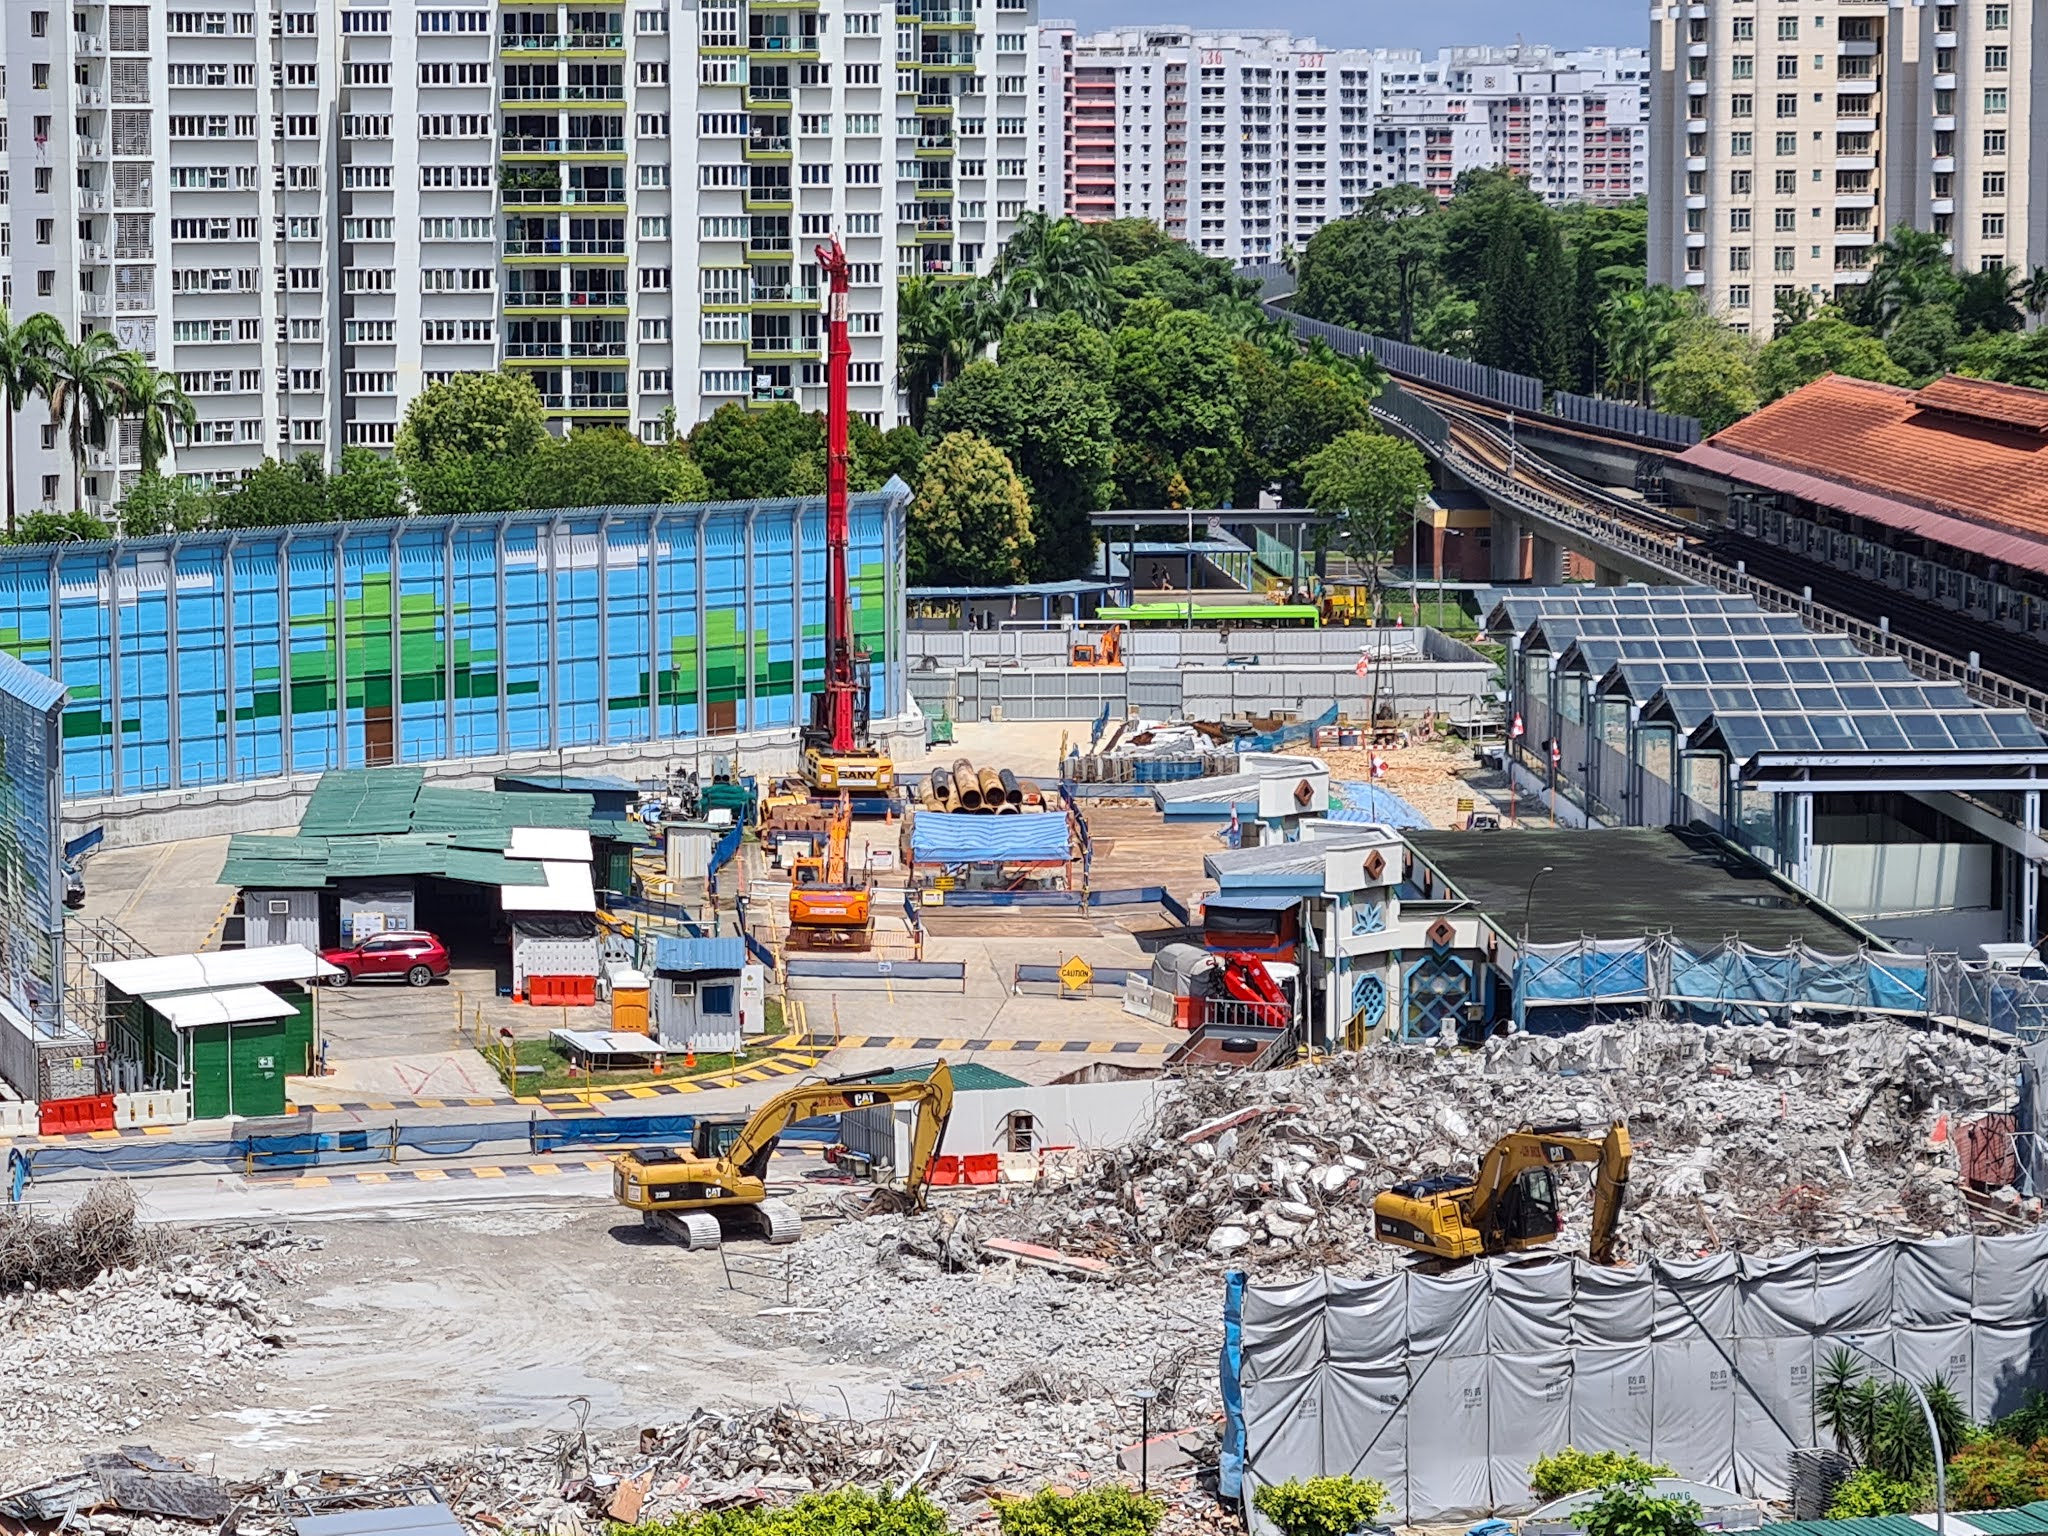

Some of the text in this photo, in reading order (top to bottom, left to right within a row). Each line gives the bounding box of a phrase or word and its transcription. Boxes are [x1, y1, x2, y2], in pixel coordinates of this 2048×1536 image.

[838, 771, 877, 779] SANY
[1061, 969, 1089, 977] CAUTION
[854, 1092, 875, 1107] CAT
[1549, 1146, 1565, 1162] CAT
[705, 1187, 722, 1198] CAT
[1662, 1492, 1691, 1500] HONG
